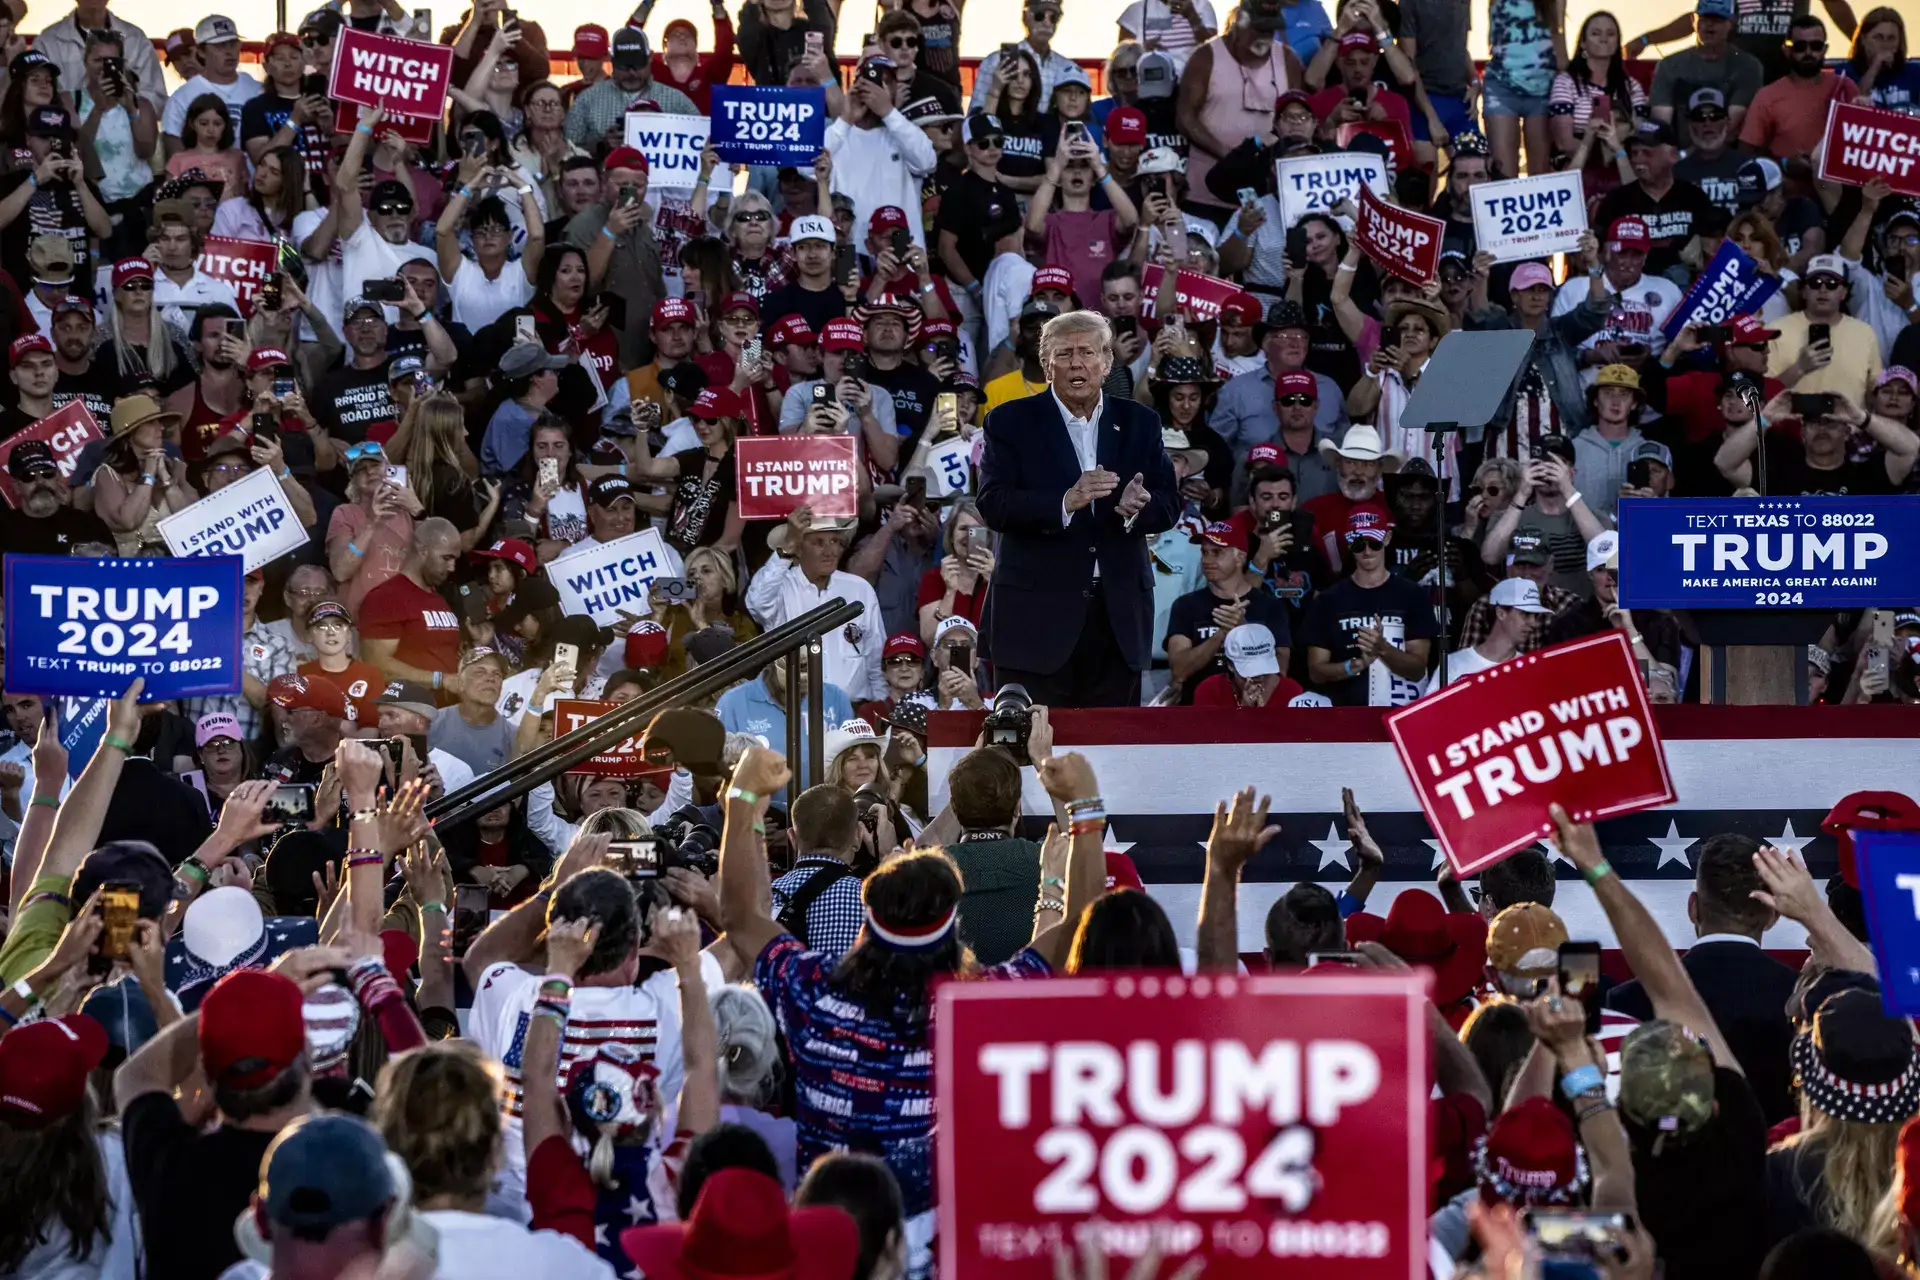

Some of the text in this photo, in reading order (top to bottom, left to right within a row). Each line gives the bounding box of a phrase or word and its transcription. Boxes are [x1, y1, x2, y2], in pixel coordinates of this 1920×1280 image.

[351, 47, 440, 82] WITCH
[353, 71, 429, 102] HUNT
[723, 101, 814, 122] TRUMP
[639, 132, 705, 151] WITC
[735, 121, 801, 142] 2024
[744, 142, 773, 151] TRUMP
[776, 144, 787, 152] TO
[789, 144, 815, 152] 88022
[1003, 136, 1043, 154] RUMP
[645, 153, 699, 170] HUN
[1842, 146, 1915, 177] HUNT
[1291, 168, 1377, 190] TRUMP
[1485, 189, 1571, 217] TRUMP
[800, 222, 824, 233] USA
[1362, 199, 1430, 248] TRUMP
[1501, 210, 1563, 235] 2024
[1368, 223, 1416, 262] 2024
[1511, 235, 1539, 244] TRUMP
[1555, 229, 1579, 239] 88022
[119, 260, 149, 273] TRUMP
[1690, 258, 1740, 322] RUMP
[660, 304, 688, 313] AMERICA
[1710, 281, 1746, 323] 024
[772, 331, 785, 342] 45
[828, 324, 843, 332] MAKE
[830, 332, 846, 340] GREAT
[257, 349, 287, 360] TRUMP
[335, 392, 377, 408] RRHOID
[341, 409, 371, 424] ROAD
[747, 460, 847, 473] I STAND WITH
[599, 480, 630, 492] TRUMP
[745, 475, 850, 497] TRUMP
[182, 495, 276, 550] I STAND WITH
[1349, 514, 1380, 523] TRUMP
[1686, 514, 1875, 528] TEXT TEXAS TO 88022
[186, 508, 285, 557] TRUMP
[1671, 532, 1889, 571] TRUMP
[567, 551, 657, 594] WITCH
[1683, 576, 1877, 587] MAKE AMERICA GREAT AGAIN!
[30, 584, 219, 621] TRUMP
[583, 576, 654, 615] HUNT
[1755, 592, 1804, 605] 2024
[57, 621, 193, 656] 2024
[27, 656, 222, 675] TEXT TRUMP TO 88022
[201, 716, 233, 730] TRUMP
[1427, 686, 1629, 777] I STAND WITH
[63, 725, 82, 750] TEXT
[1435, 716, 1642, 820] TRUMP
[971, 832, 1002, 840] SONY
[978, 1038, 1381, 1129] TRUMP
[1034, 1122, 1318, 1214] 2024
[1497, 1156, 1557, 1188] Trump
